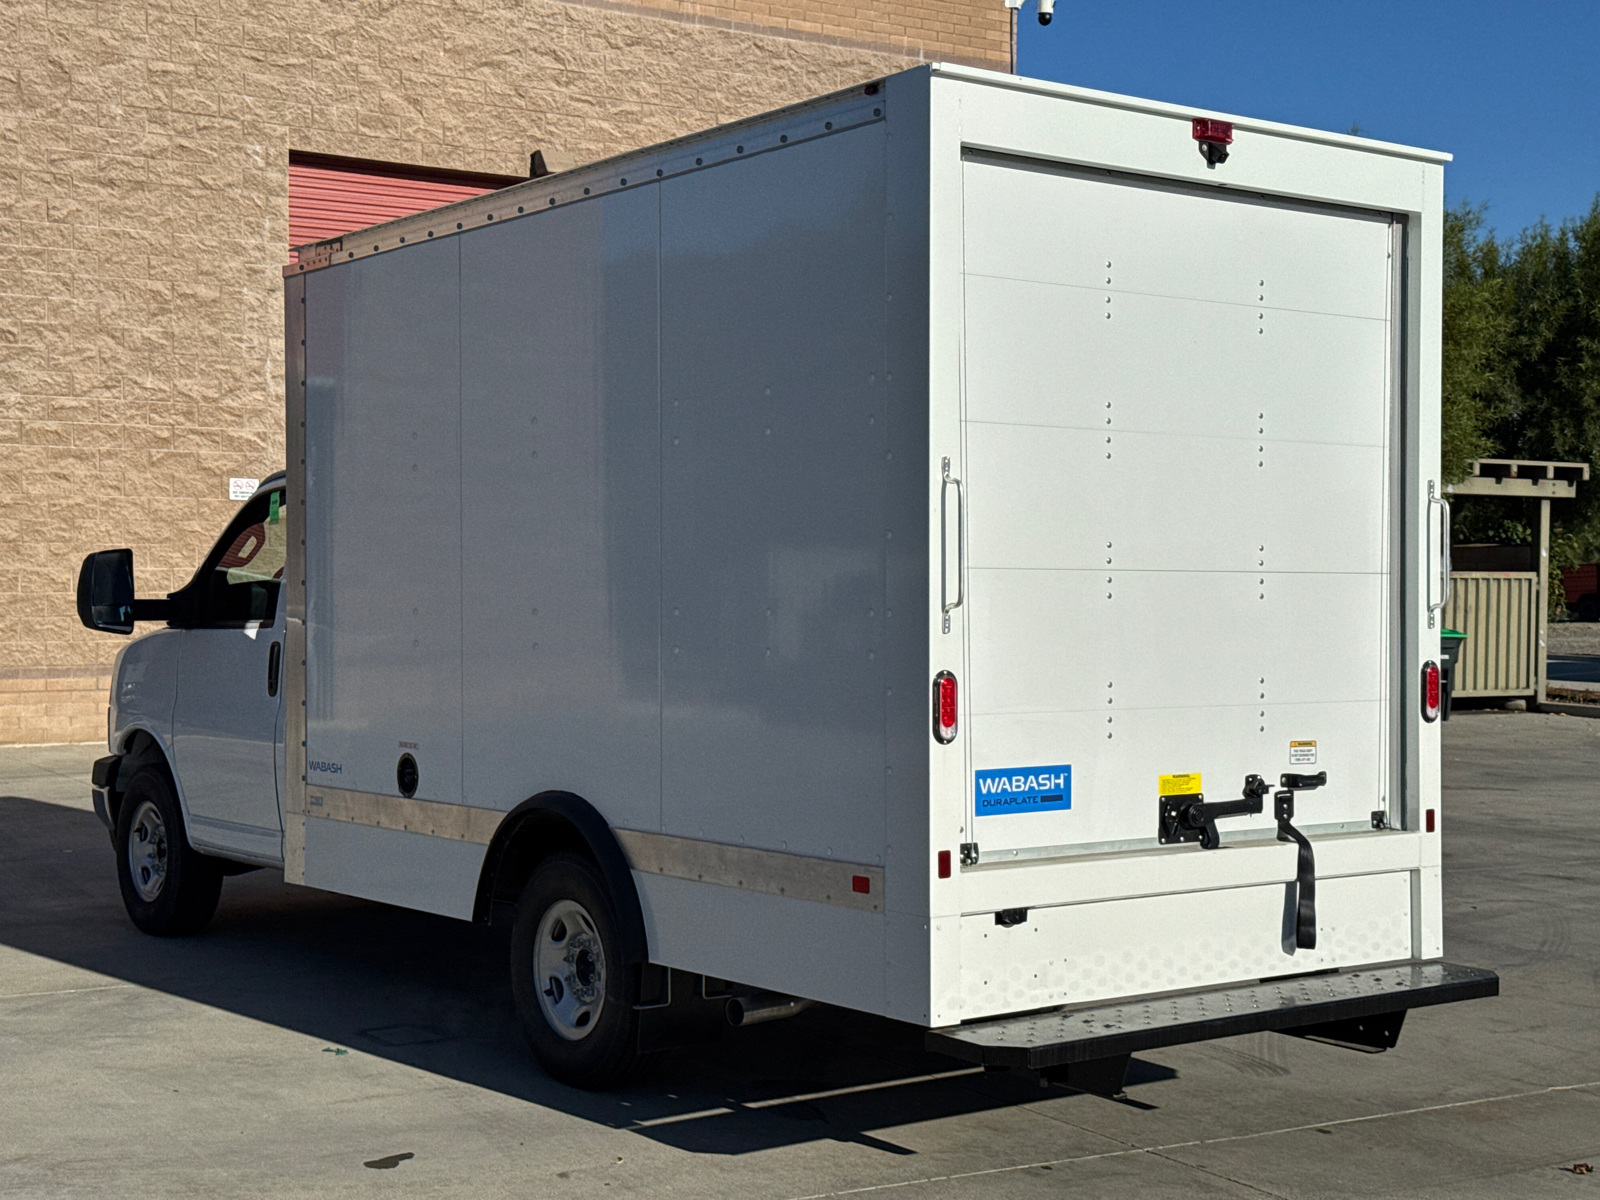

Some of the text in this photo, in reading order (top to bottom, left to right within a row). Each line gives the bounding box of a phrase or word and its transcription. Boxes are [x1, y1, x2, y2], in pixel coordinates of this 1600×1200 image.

[308, 760, 342, 774] WABASH
[979, 773, 1064, 794] WABASH
[982, 796, 1038, 807] DURAPLATE
